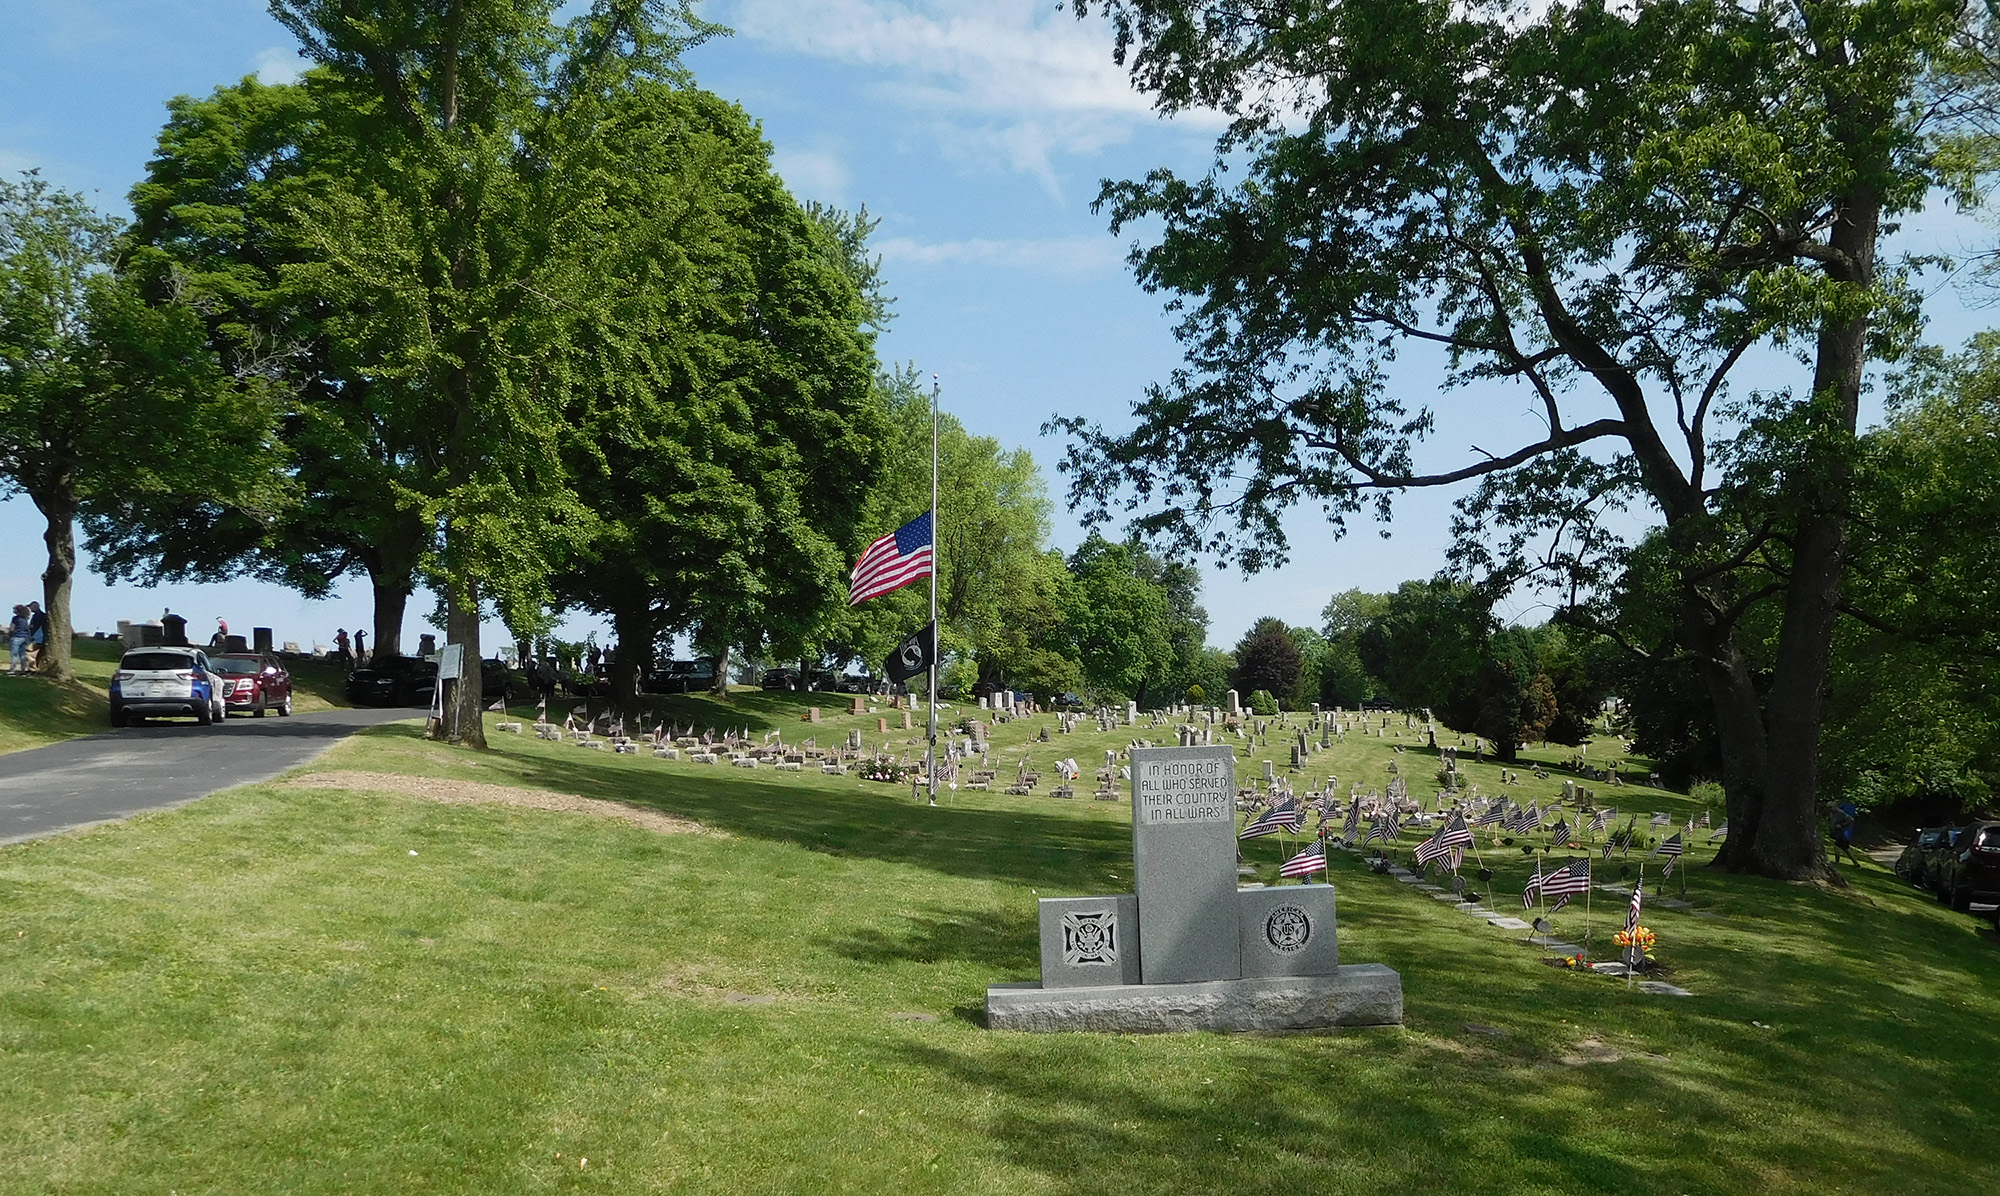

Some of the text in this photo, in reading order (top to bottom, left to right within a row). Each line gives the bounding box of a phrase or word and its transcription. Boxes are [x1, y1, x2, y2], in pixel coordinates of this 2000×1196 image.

[1149, 762, 1220, 776] IN HONOR OF
[1141, 777, 1227, 791] ALL WHO SERVED
[1142, 792, 1227, 805] THEIR COUNTRY
[1151, 807, 1220, 820] IN ALL WARS
[1283, 924, 1294, 935] US
